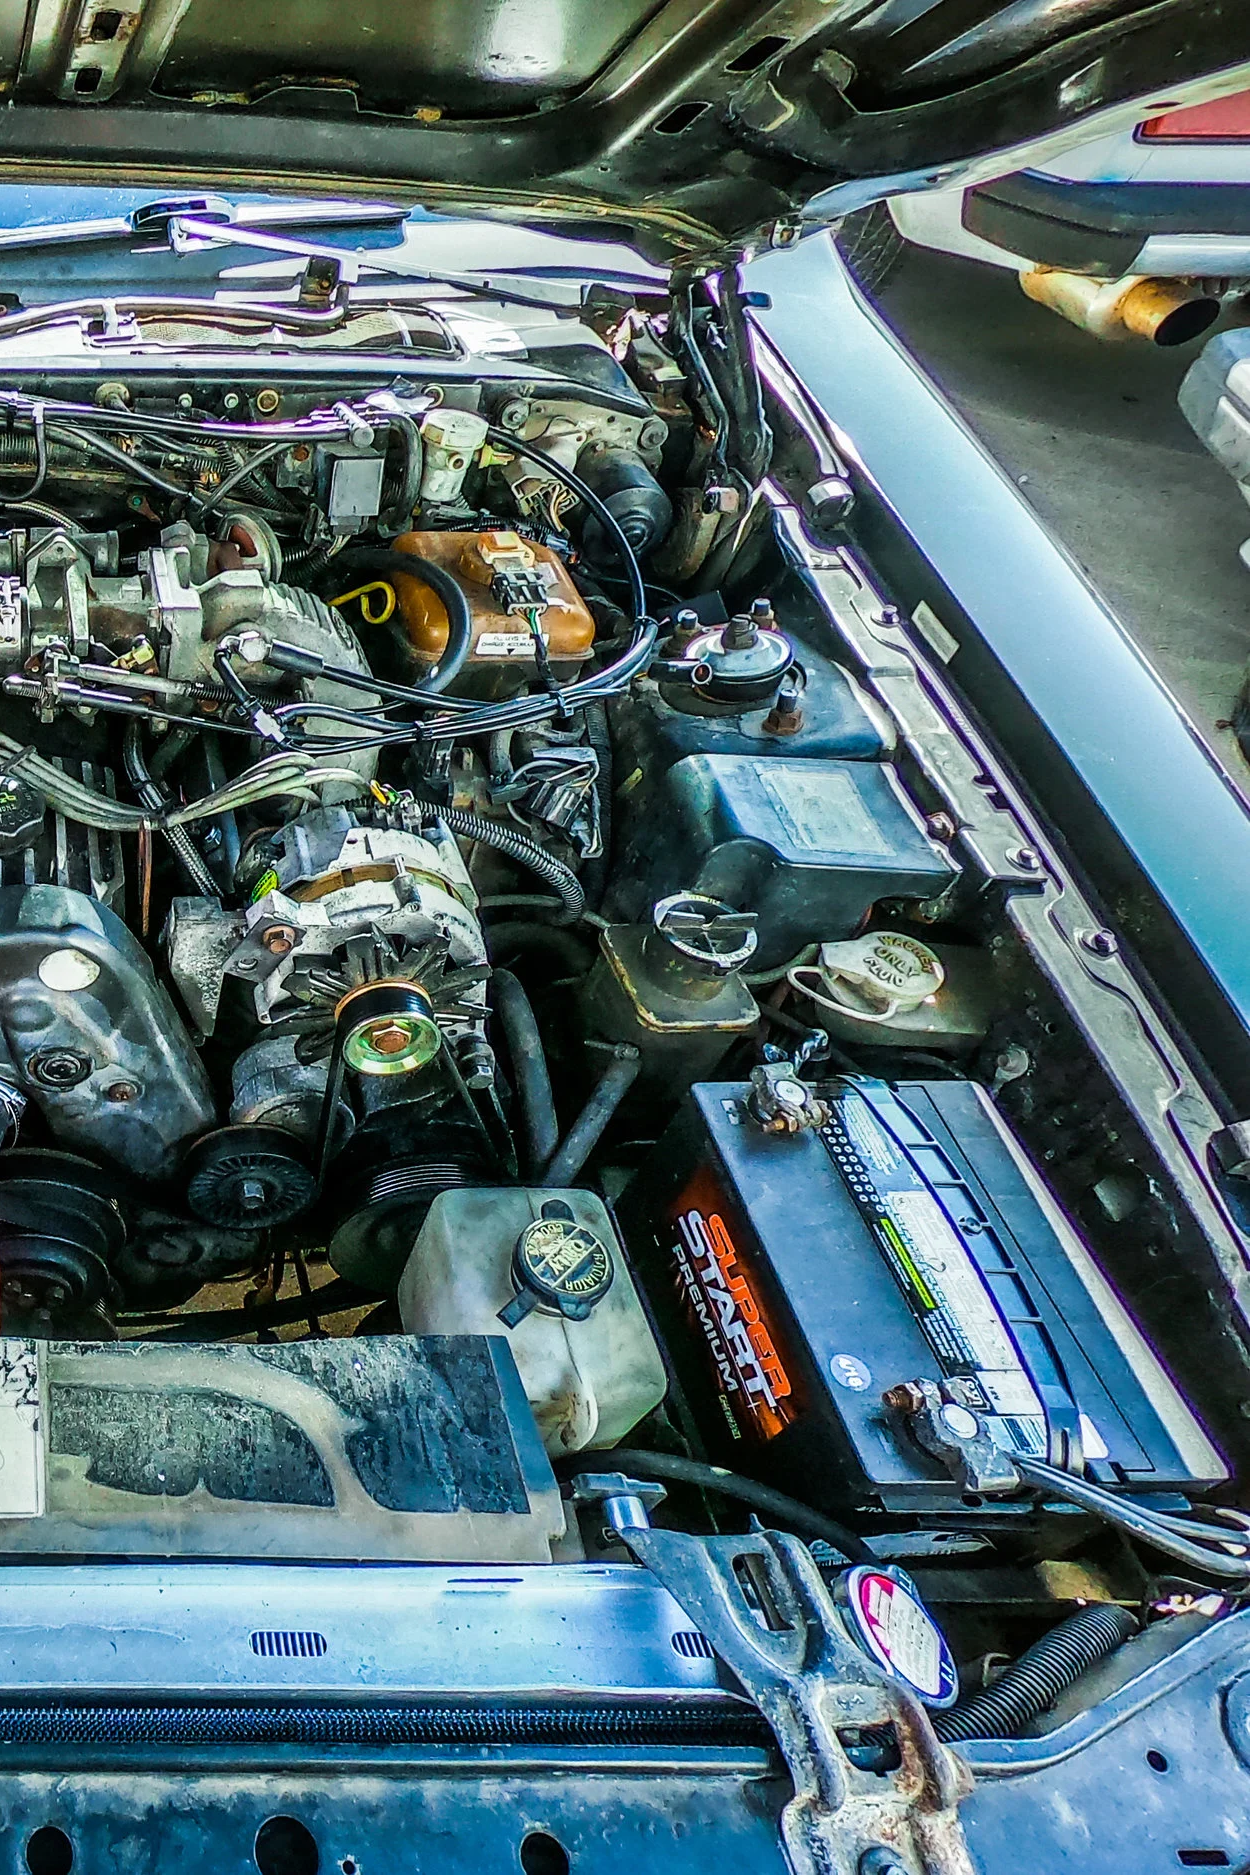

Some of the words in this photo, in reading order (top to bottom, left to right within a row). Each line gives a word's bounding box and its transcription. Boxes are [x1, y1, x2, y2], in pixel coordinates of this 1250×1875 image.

[863, 957, 905, 987] FLUID
[873, 946, 920, 977] ONLY
[877, 936, 935, 974] WASHER
[565, 1253, 605, 1291] RADIATOR
[672, 1243, 739, 1391] PREMIUM
[678, 1210, 778, 1408] START
[703, 1213, 792, 1400] SUPER
